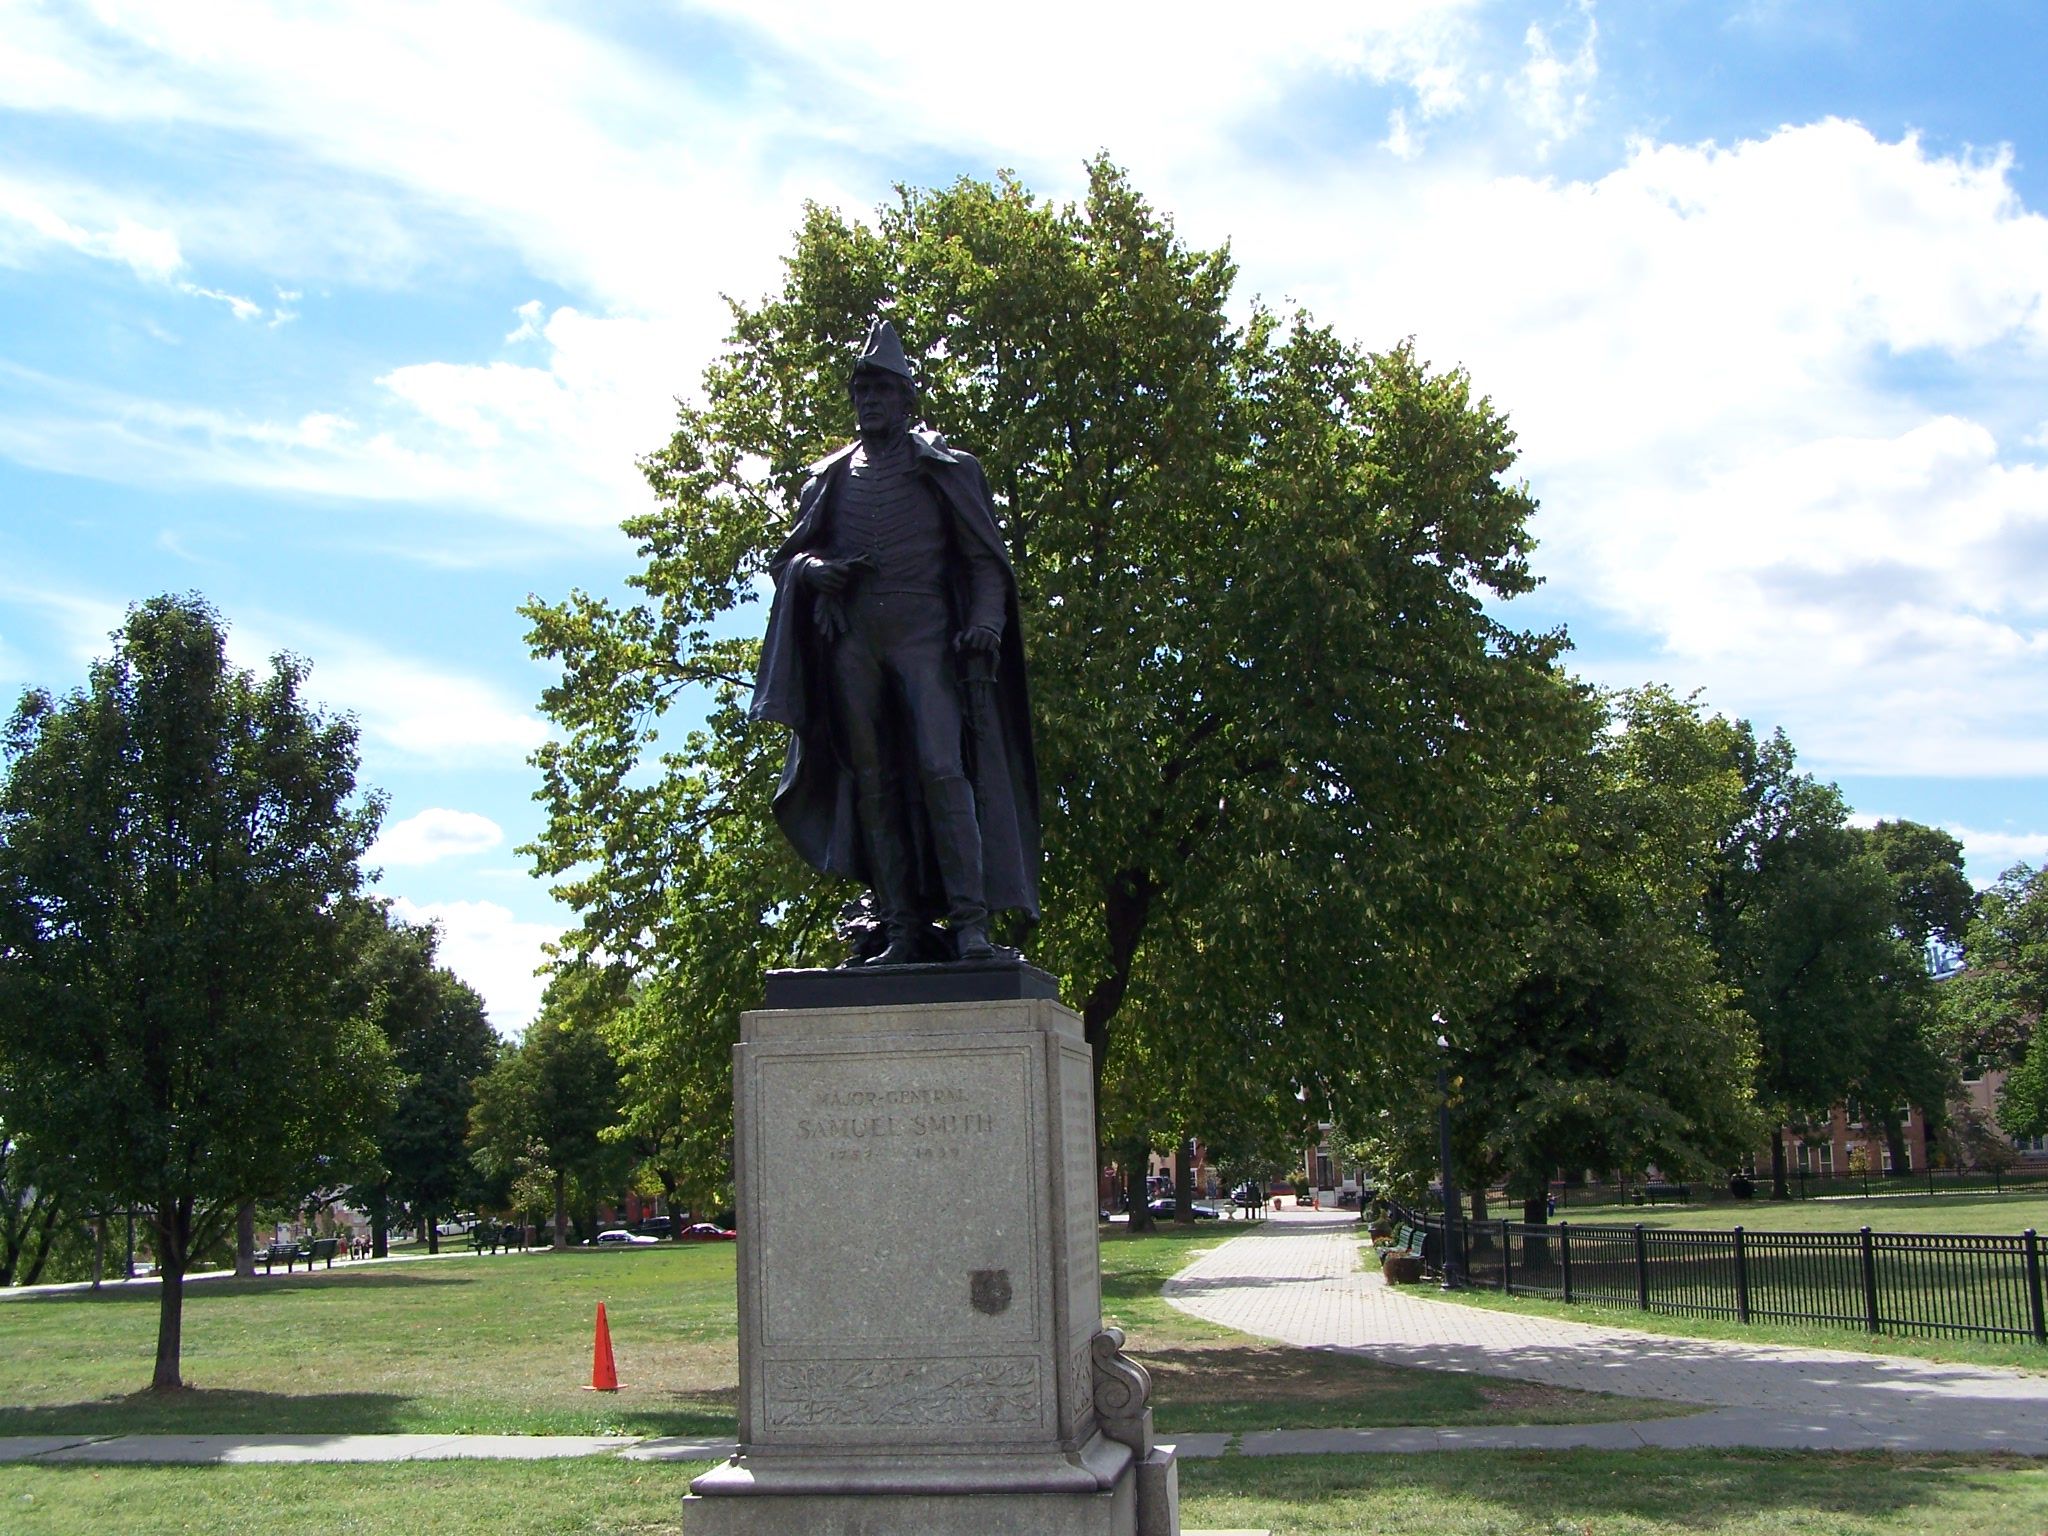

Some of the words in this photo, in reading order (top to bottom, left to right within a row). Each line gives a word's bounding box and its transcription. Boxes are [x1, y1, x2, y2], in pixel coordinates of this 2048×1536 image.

[817, 1088, 969, 1107] MAJOR-GENERAL
[797, 1116, 900, 1140] SAMUEL
[911, 1113, 993, 1137] SMITH
